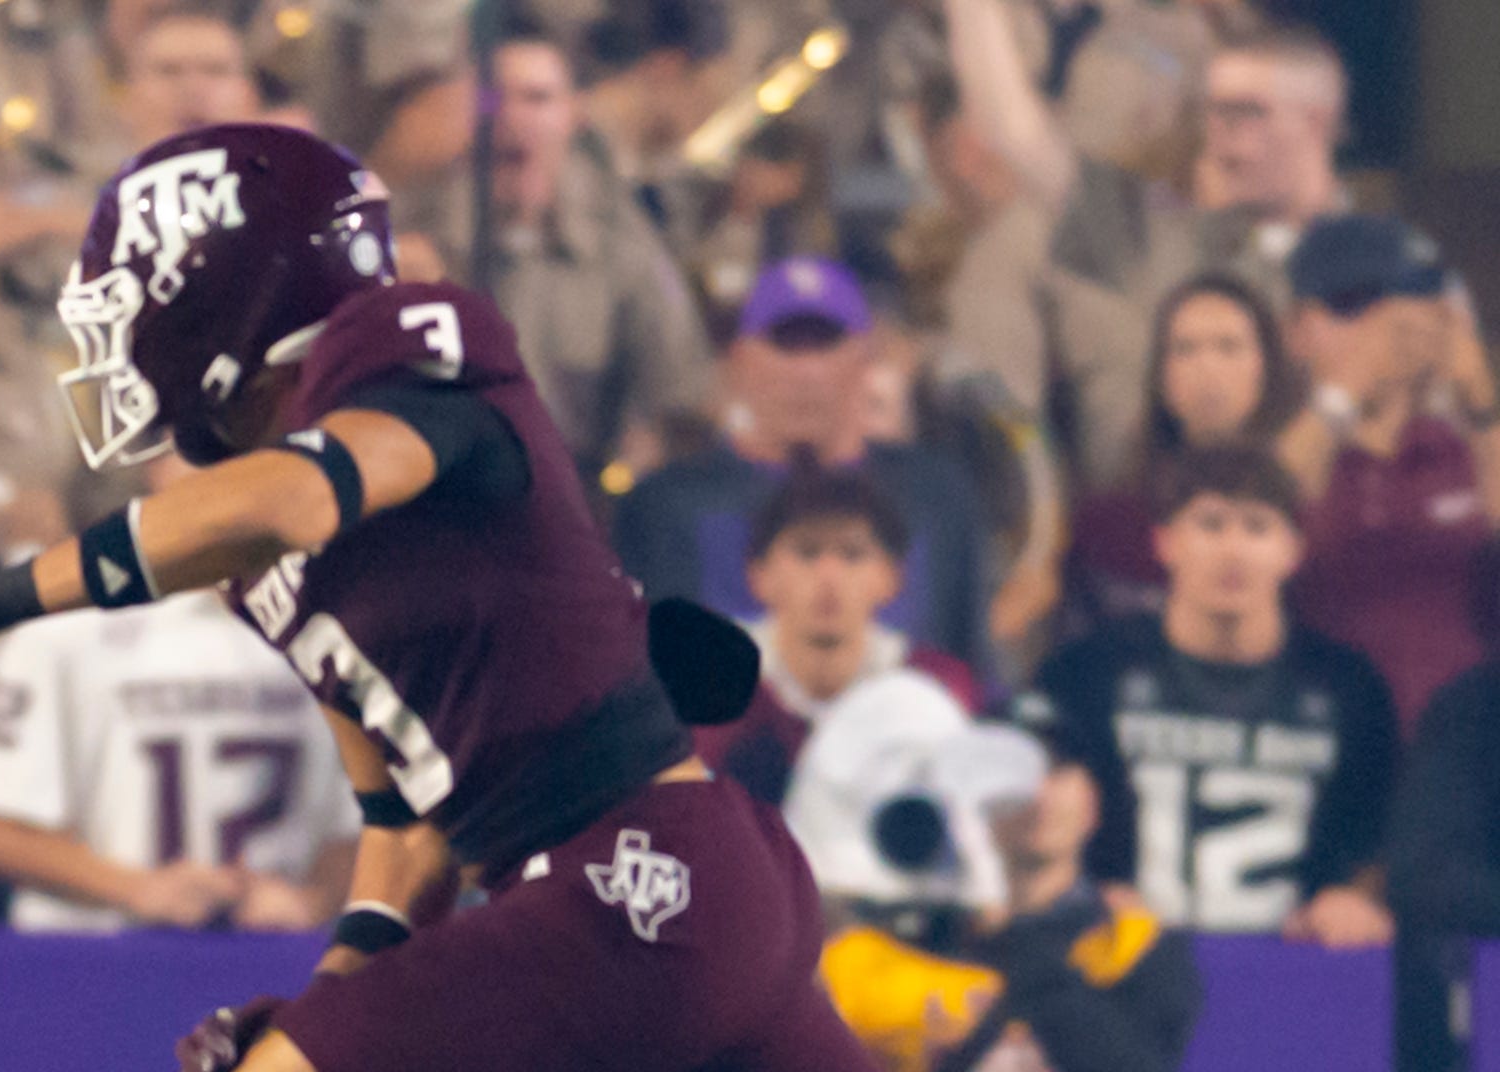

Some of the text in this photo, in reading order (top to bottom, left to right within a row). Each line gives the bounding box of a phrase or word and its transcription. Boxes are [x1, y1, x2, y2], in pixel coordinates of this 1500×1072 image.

[398, 302, 464, 380] 3
[286, 611, 454, 818] 3
[1132, 762, 1313, 932] 12
